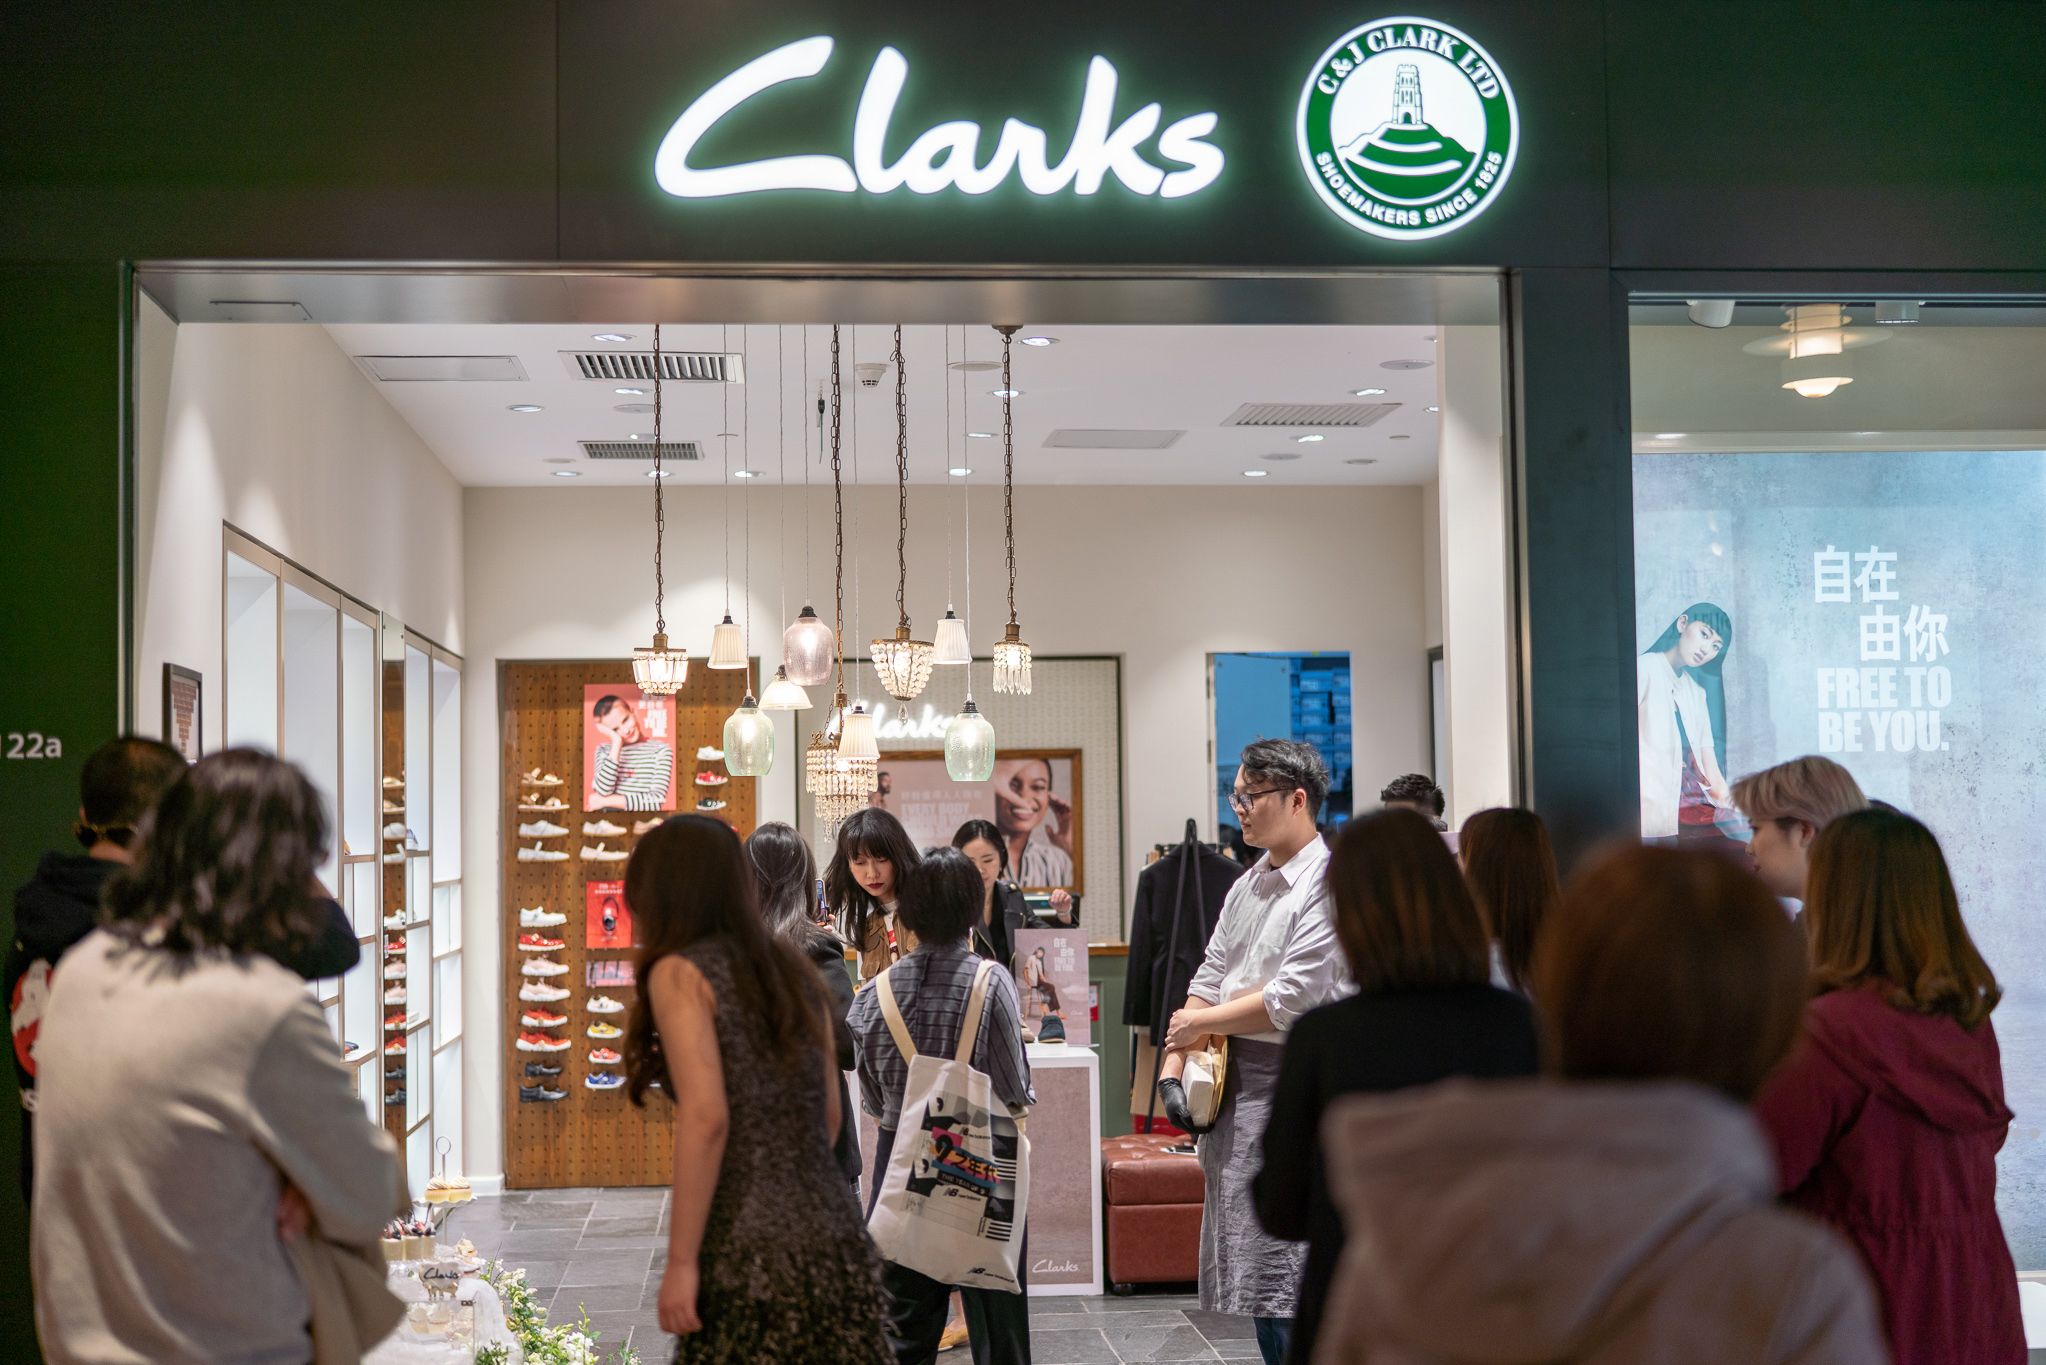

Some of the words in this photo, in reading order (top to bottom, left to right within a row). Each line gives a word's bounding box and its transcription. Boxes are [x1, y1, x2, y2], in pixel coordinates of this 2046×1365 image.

[1366, 26, 1460, 60] CLARK
[1457, 50, 1500, 99] LTD
[655, 35, 1225, 199] Clarks
[1316, 151, 1421, 226] SHOEMAKERS
[1424, 188, 1478, 224] SINCE
[1474, 151, 1503, 190] 1825
[1813, 544, 1899, 603] 自在
[1859, 604, 1951, 662] 由你
[1816, 667, 1898, 709] FREE
[1903, 665, 1952, 708] TO
[0, 732, 62, 759] 22a
[1818, 711, 1863, 753] BE
[1867, 710, 1950, 753] YOU.
[1031, 1258, 1080, 1274] Clarks
